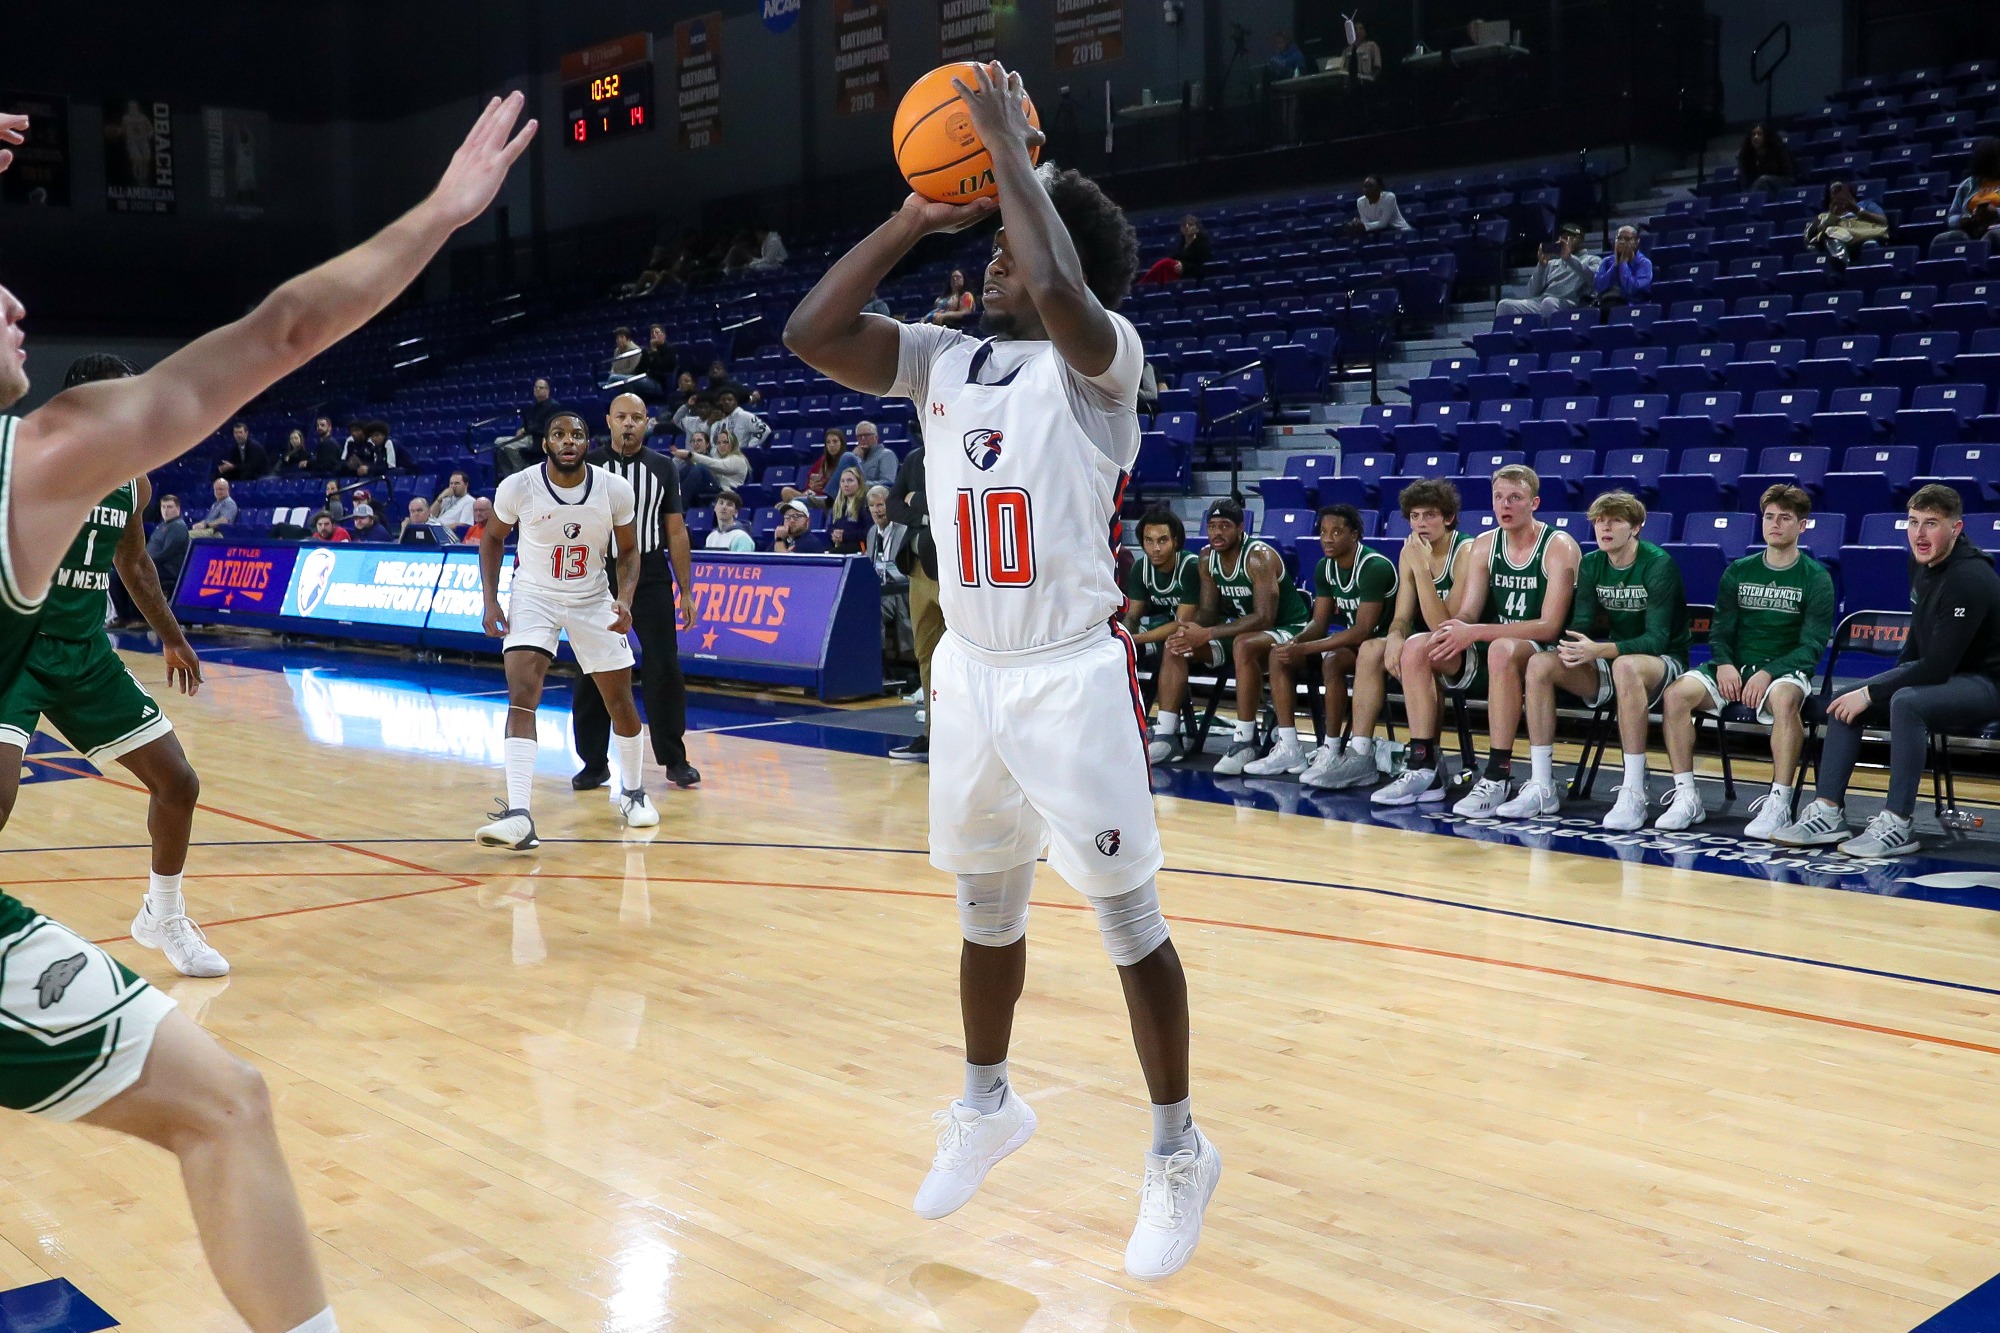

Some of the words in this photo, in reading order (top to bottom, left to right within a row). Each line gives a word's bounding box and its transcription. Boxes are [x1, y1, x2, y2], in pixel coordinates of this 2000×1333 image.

[840, 25, 883, 50] NATIONAL
[835, 43, 890, 73] CHAMPIONS
[1072, 40, 1104, 66] 2016
[591, 74, 620, 101] 10:52
[850, 92, 875, 113] 2013
[574, 119, 587, 142] 13
[603, 117, 608, 132] 1
[630, 105, 645, 126] 14
[958, 168, 995, 195] VO
[85, 505, 128, 529] TERN
[83, 529, 98, 566] 1
[954, 486, 1037, 589] 10
[226, 548, 237, 557] UT
[238, 548, 261, 558] TYLER
[551, 545, 590, 581] 13
[203, 559, 273, 589] PATRIOTS
[374, 561, 457, 588] WELCOME
[453, 563, 479, 589] TO
[695, 565, 714, 578] UT
[718, 566, 762, 581] TYLER
[672, 581, 791, 626] TRIOTS
[1504, 591, 1527, 617] 44
[1764, 587, 1781, 599] NEW
[1954, 607, 1966, 617] 22
[1873, 625, 1911, 641] TYL
